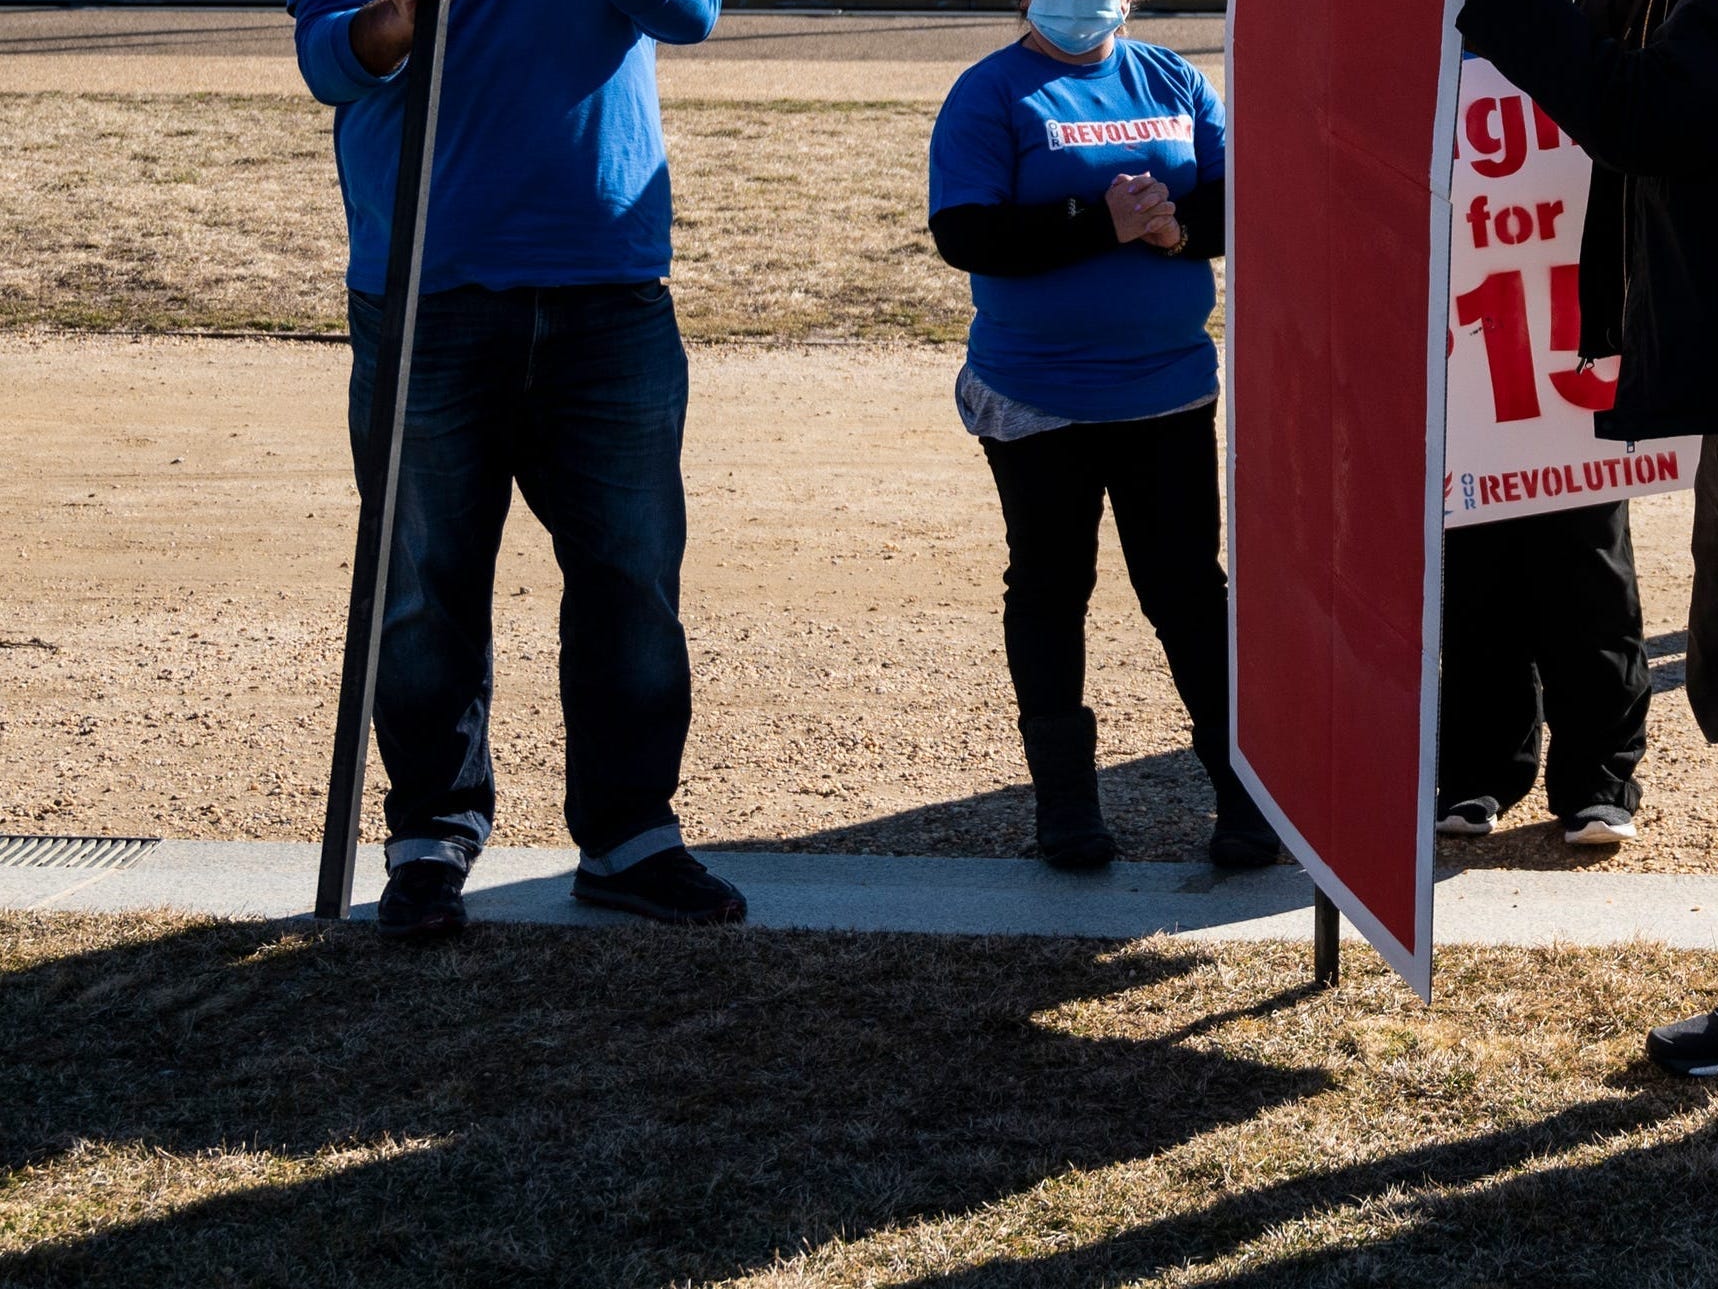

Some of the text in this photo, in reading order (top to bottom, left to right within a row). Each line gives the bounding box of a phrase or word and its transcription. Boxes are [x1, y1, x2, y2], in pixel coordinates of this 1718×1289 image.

[1465, 194, 1565, 250] for
[1447, 264, 1619, 423] 15
[1461, 472, 1477, 510] OUR
[1479, 450, 1679, 505] REVOLUTION
